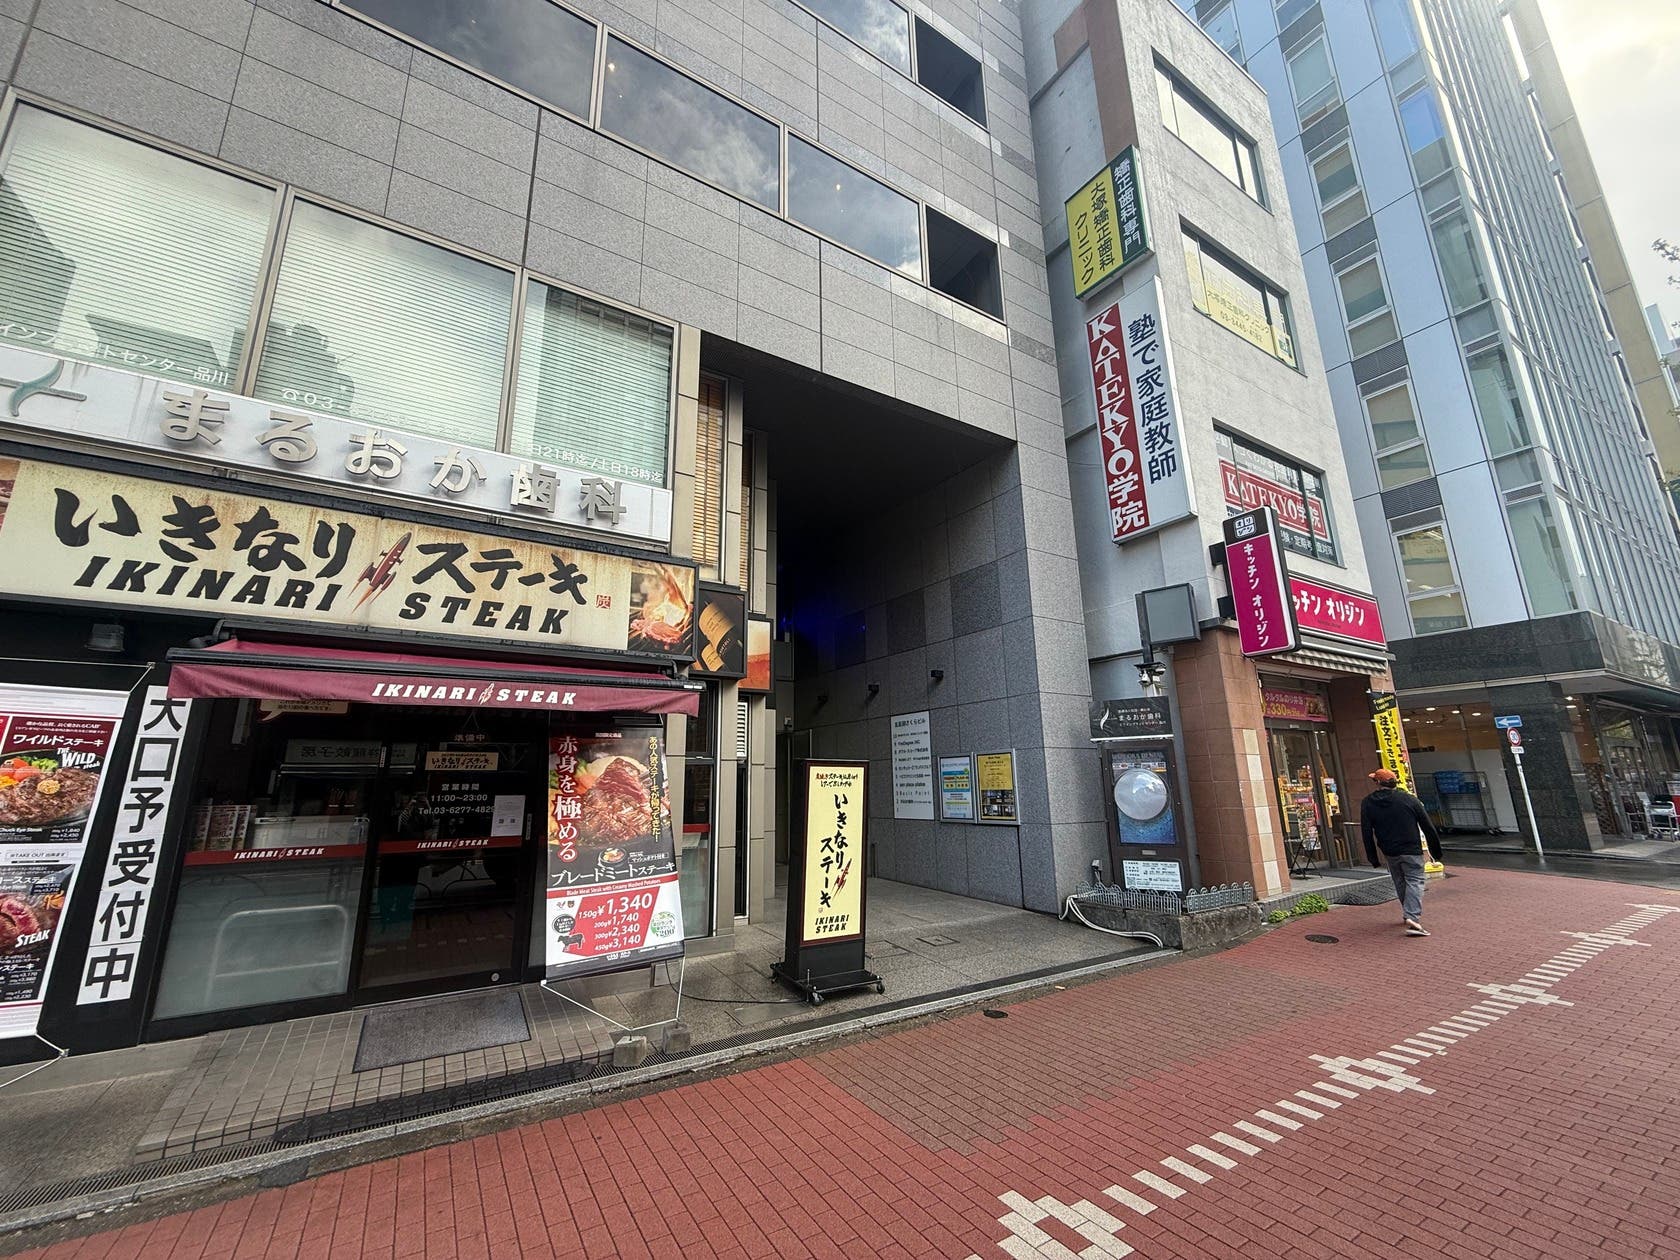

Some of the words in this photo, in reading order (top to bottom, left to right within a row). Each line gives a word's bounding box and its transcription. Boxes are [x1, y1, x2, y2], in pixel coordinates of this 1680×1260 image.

[1090, 181, 1116, 271] 大塚矯正歯科
[1113, 157, 1141, 254] 矯正歯科専門
[1074, 211, 1095, 285] クリニック
[1088, 308, 1145, 536] KATEKYO学院
[1127, 312, 1177, 485] 塾で家庭教師
[158, 389, 628, 525] まるおか歯科
[54, 487, 357, 579] いきなり
[411, 541, 589, 606] ステーキ
[73, 555, 344, 611] IKINARI
[398, 591, 570, 635] STEAK
[1243, 543, 1260, 590] キッチン
[1252, 594, 1270, 647] オリジン
[1325, 597, 1365, 627] オリジン
[371, 683, 478, 700] IKINARI
[496, 689, 577, 706] STEAK
[13, 734, 104, 748] ワイルドステーキ
[62, 751, 96, 767] WILD
[553, 735, 582, 861] 赤身を極める
[834, 793, 849, 870] いきなり
[84, 699, 187, 999] 大口予受付中
[233, 851, 278, 859] IKINARI
[286, 848, 324, 856] STEAK
[416, 841, 453, 849] IKINARI
[458, 839, 489, 847] STEAK
[551, 862, 676, 887] ブレードミートステーキ
[819, 837, 835, 908] ステーキ
[15, 930, 50, 948] STEAK
[815, 914, 850, 926] IKINARI
[815, 923, 847, 934] STEAK
